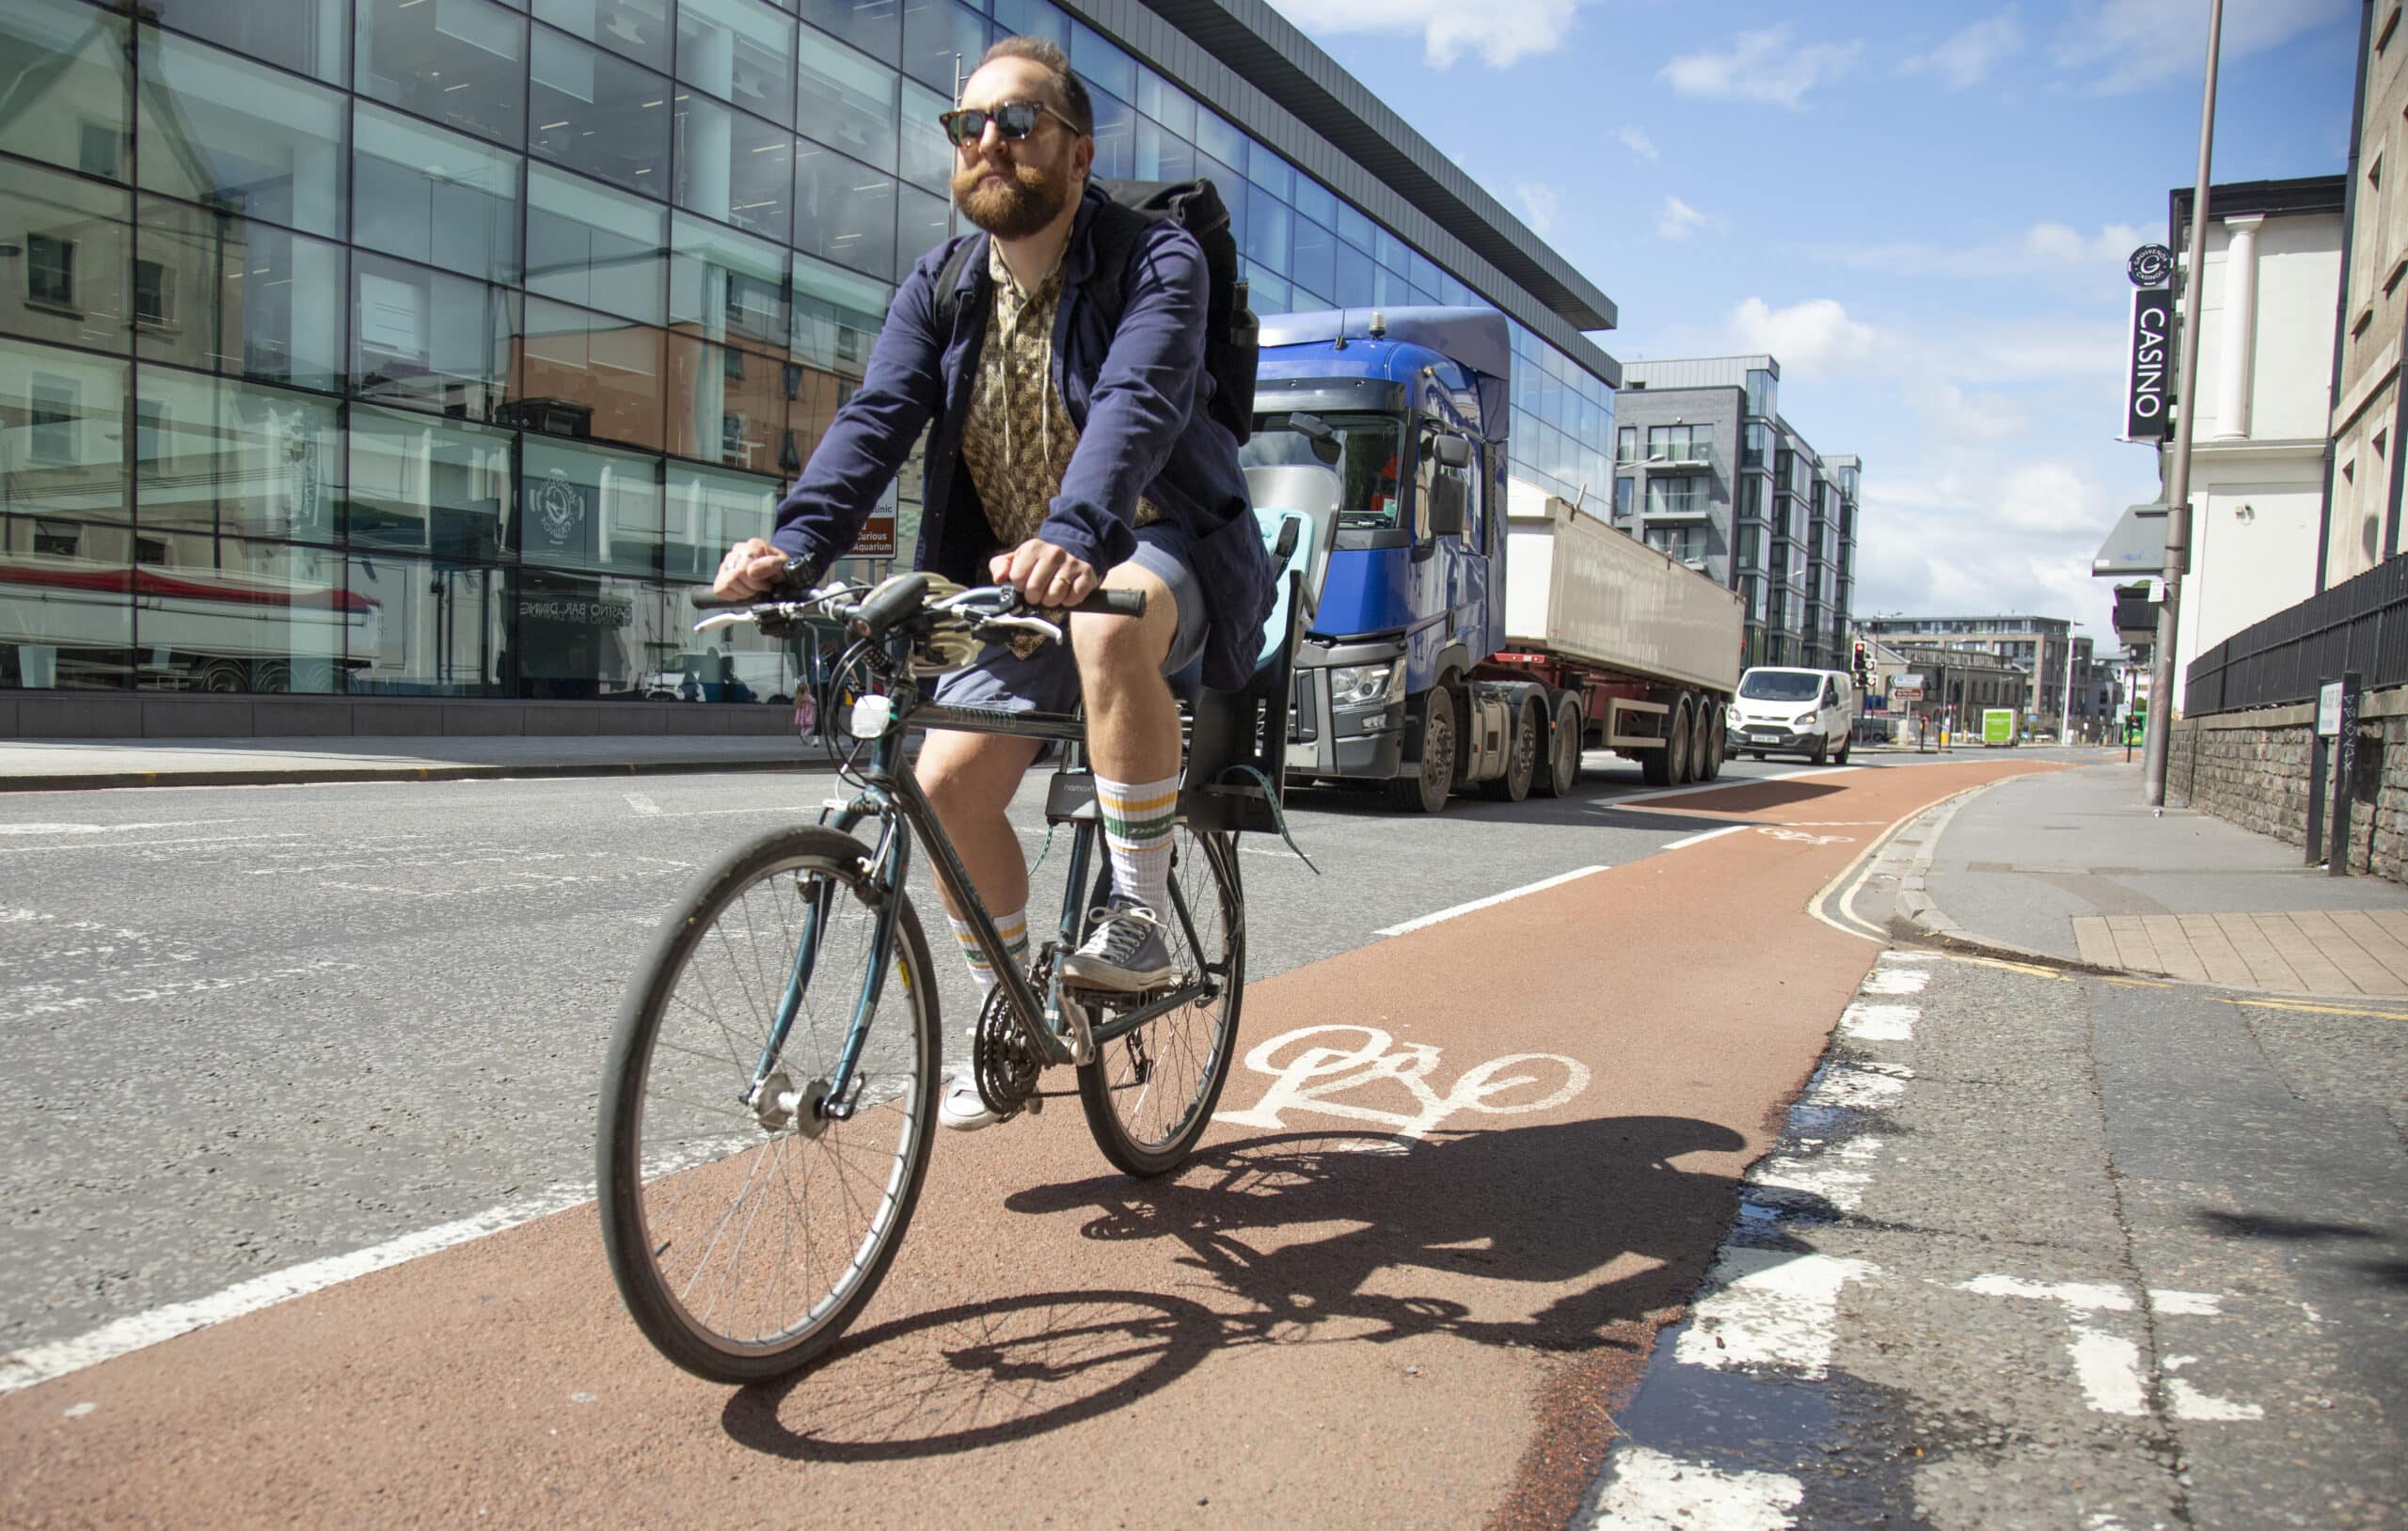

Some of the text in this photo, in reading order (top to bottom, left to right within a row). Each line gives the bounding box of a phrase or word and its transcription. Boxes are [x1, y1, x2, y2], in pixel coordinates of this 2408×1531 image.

[2133, 248, 2168, 265] GROSVENOR
[2136, 271, 2164, 281] CASINOS
[2135, 308, 2165, 418] CASINO
[873, 504, 893, 513] linic
[853, 542, 892, 552] Aquarium
